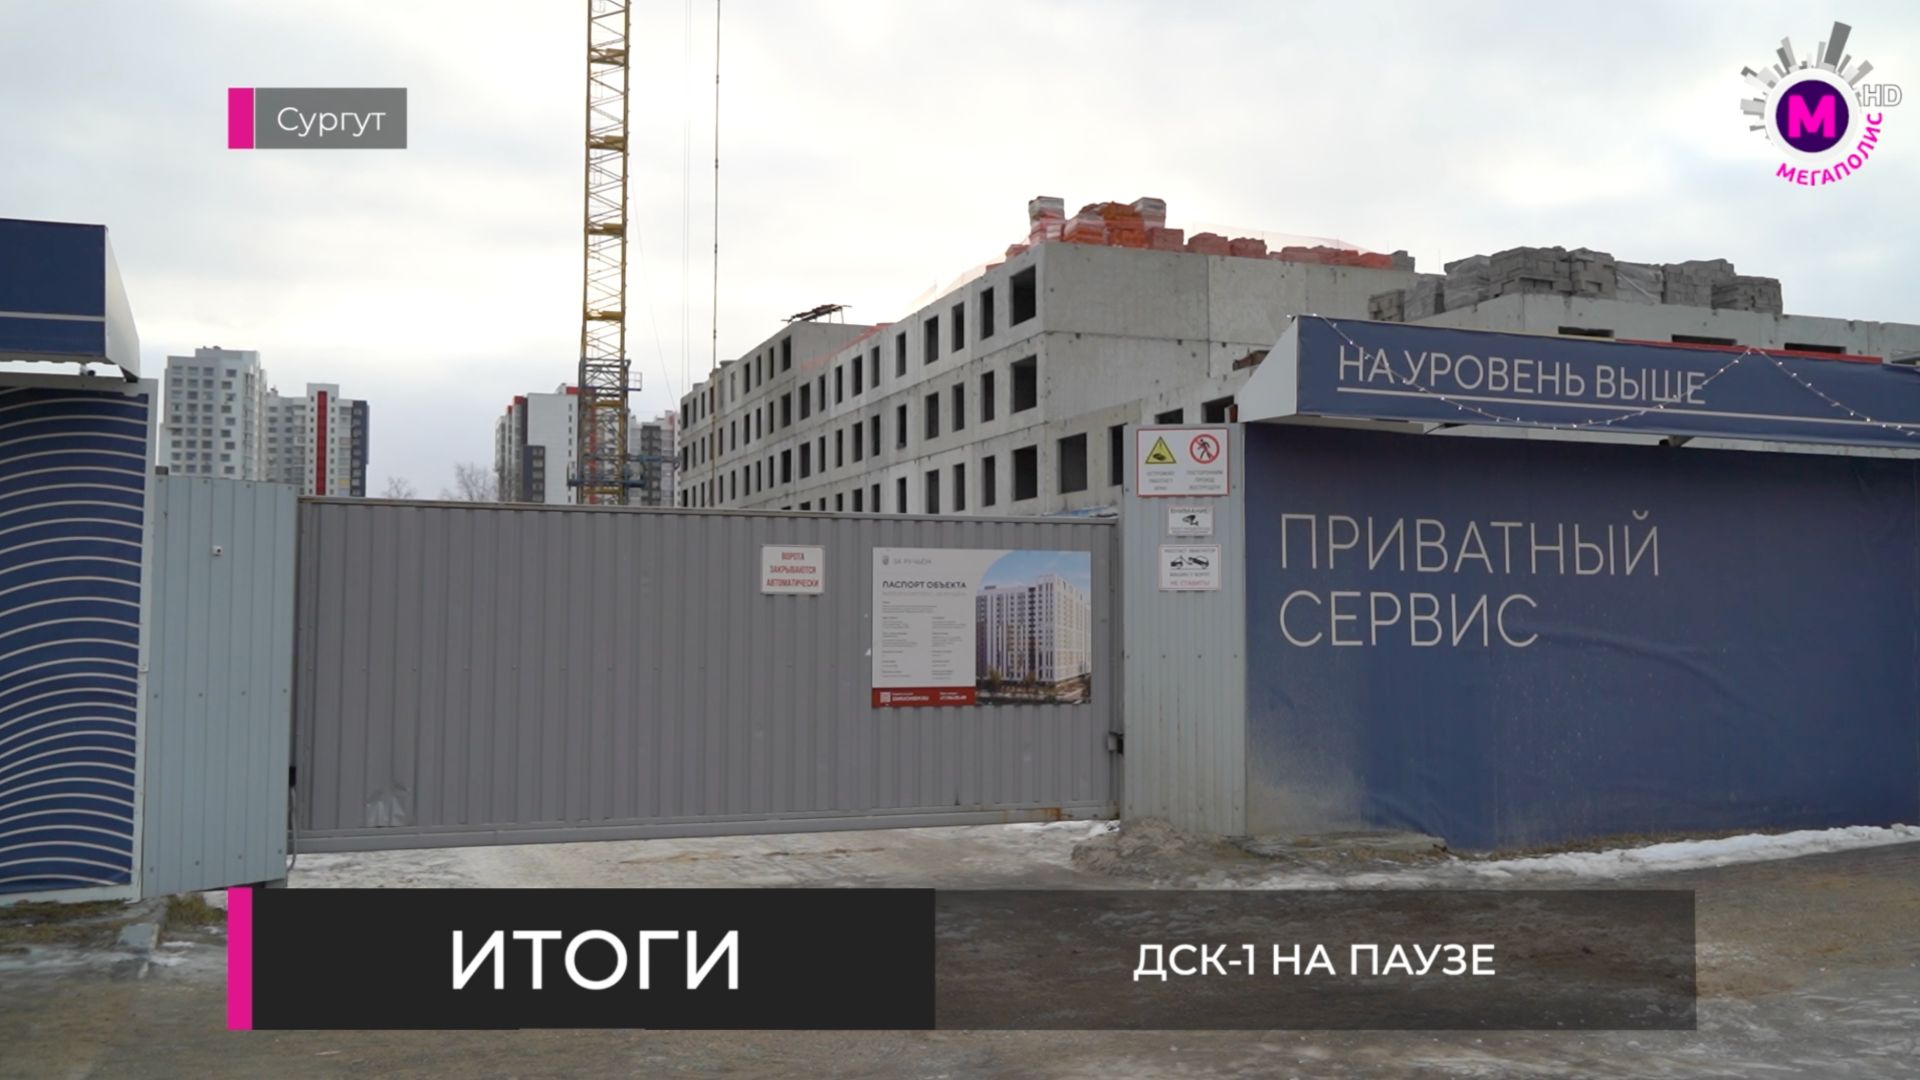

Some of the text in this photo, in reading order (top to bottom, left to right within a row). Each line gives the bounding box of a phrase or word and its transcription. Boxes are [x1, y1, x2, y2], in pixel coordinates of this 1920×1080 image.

[1339, 345, 1706, 405] НА УРОВЕНЬ ВЫШЕ
[1281, 510, 1660, 577] ПРИВАТНЫЙ
[781, 551, 805, 561] ВОРОТА
[769, 565, 817, 574] ЗАКРЫВАЮТСЯ
[766, 578, 819, 588] АВТОМАТИЧЕСКИ
[881, 580, 967, 589] ПАСПОРТ ОБЪЕКТА
[1279, 589, 1539, 648] СЕРВИС
